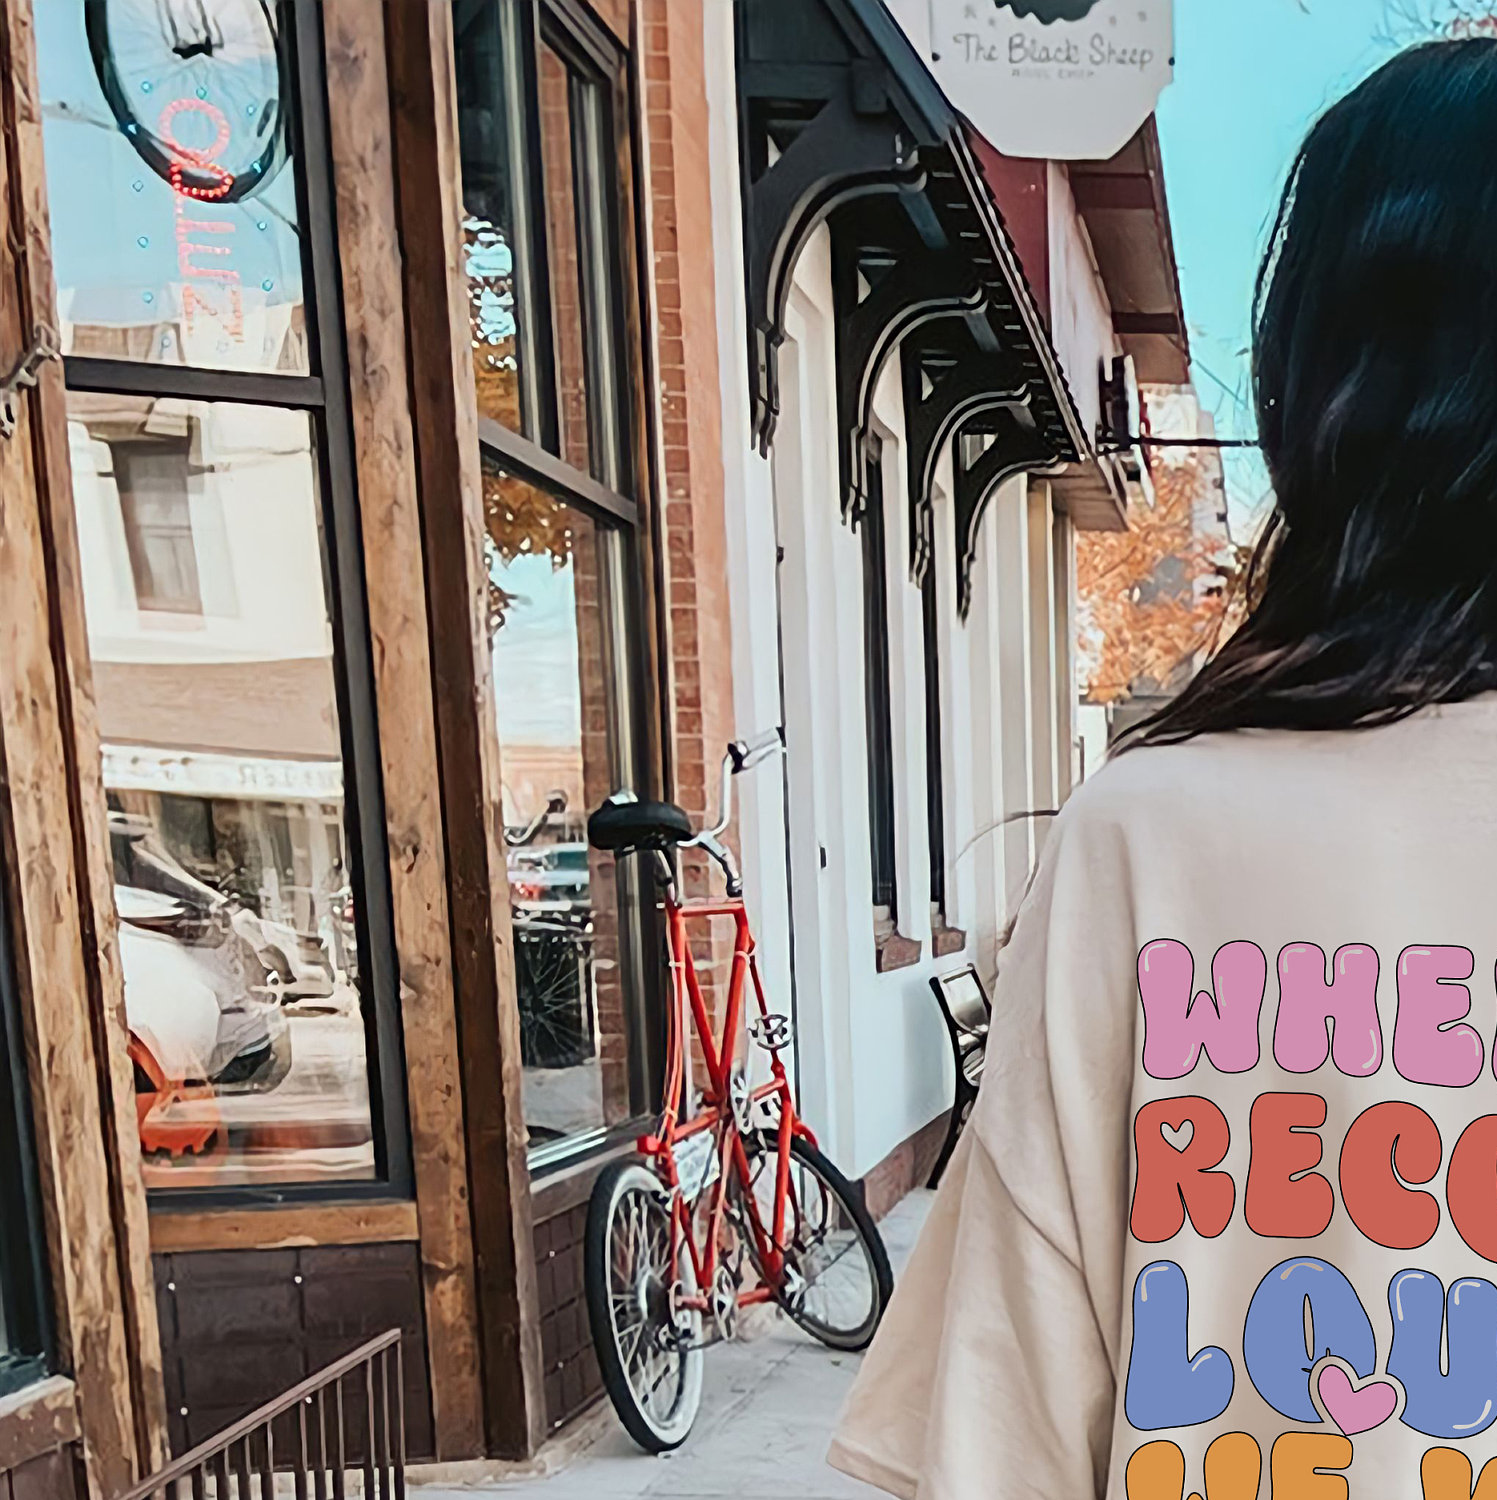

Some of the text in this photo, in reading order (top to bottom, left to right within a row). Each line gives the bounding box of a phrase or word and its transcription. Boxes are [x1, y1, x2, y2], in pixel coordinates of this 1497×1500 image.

[953, 32, 1153, 70] The Black Sheep
[158, 98, 245, 342] OPEN
